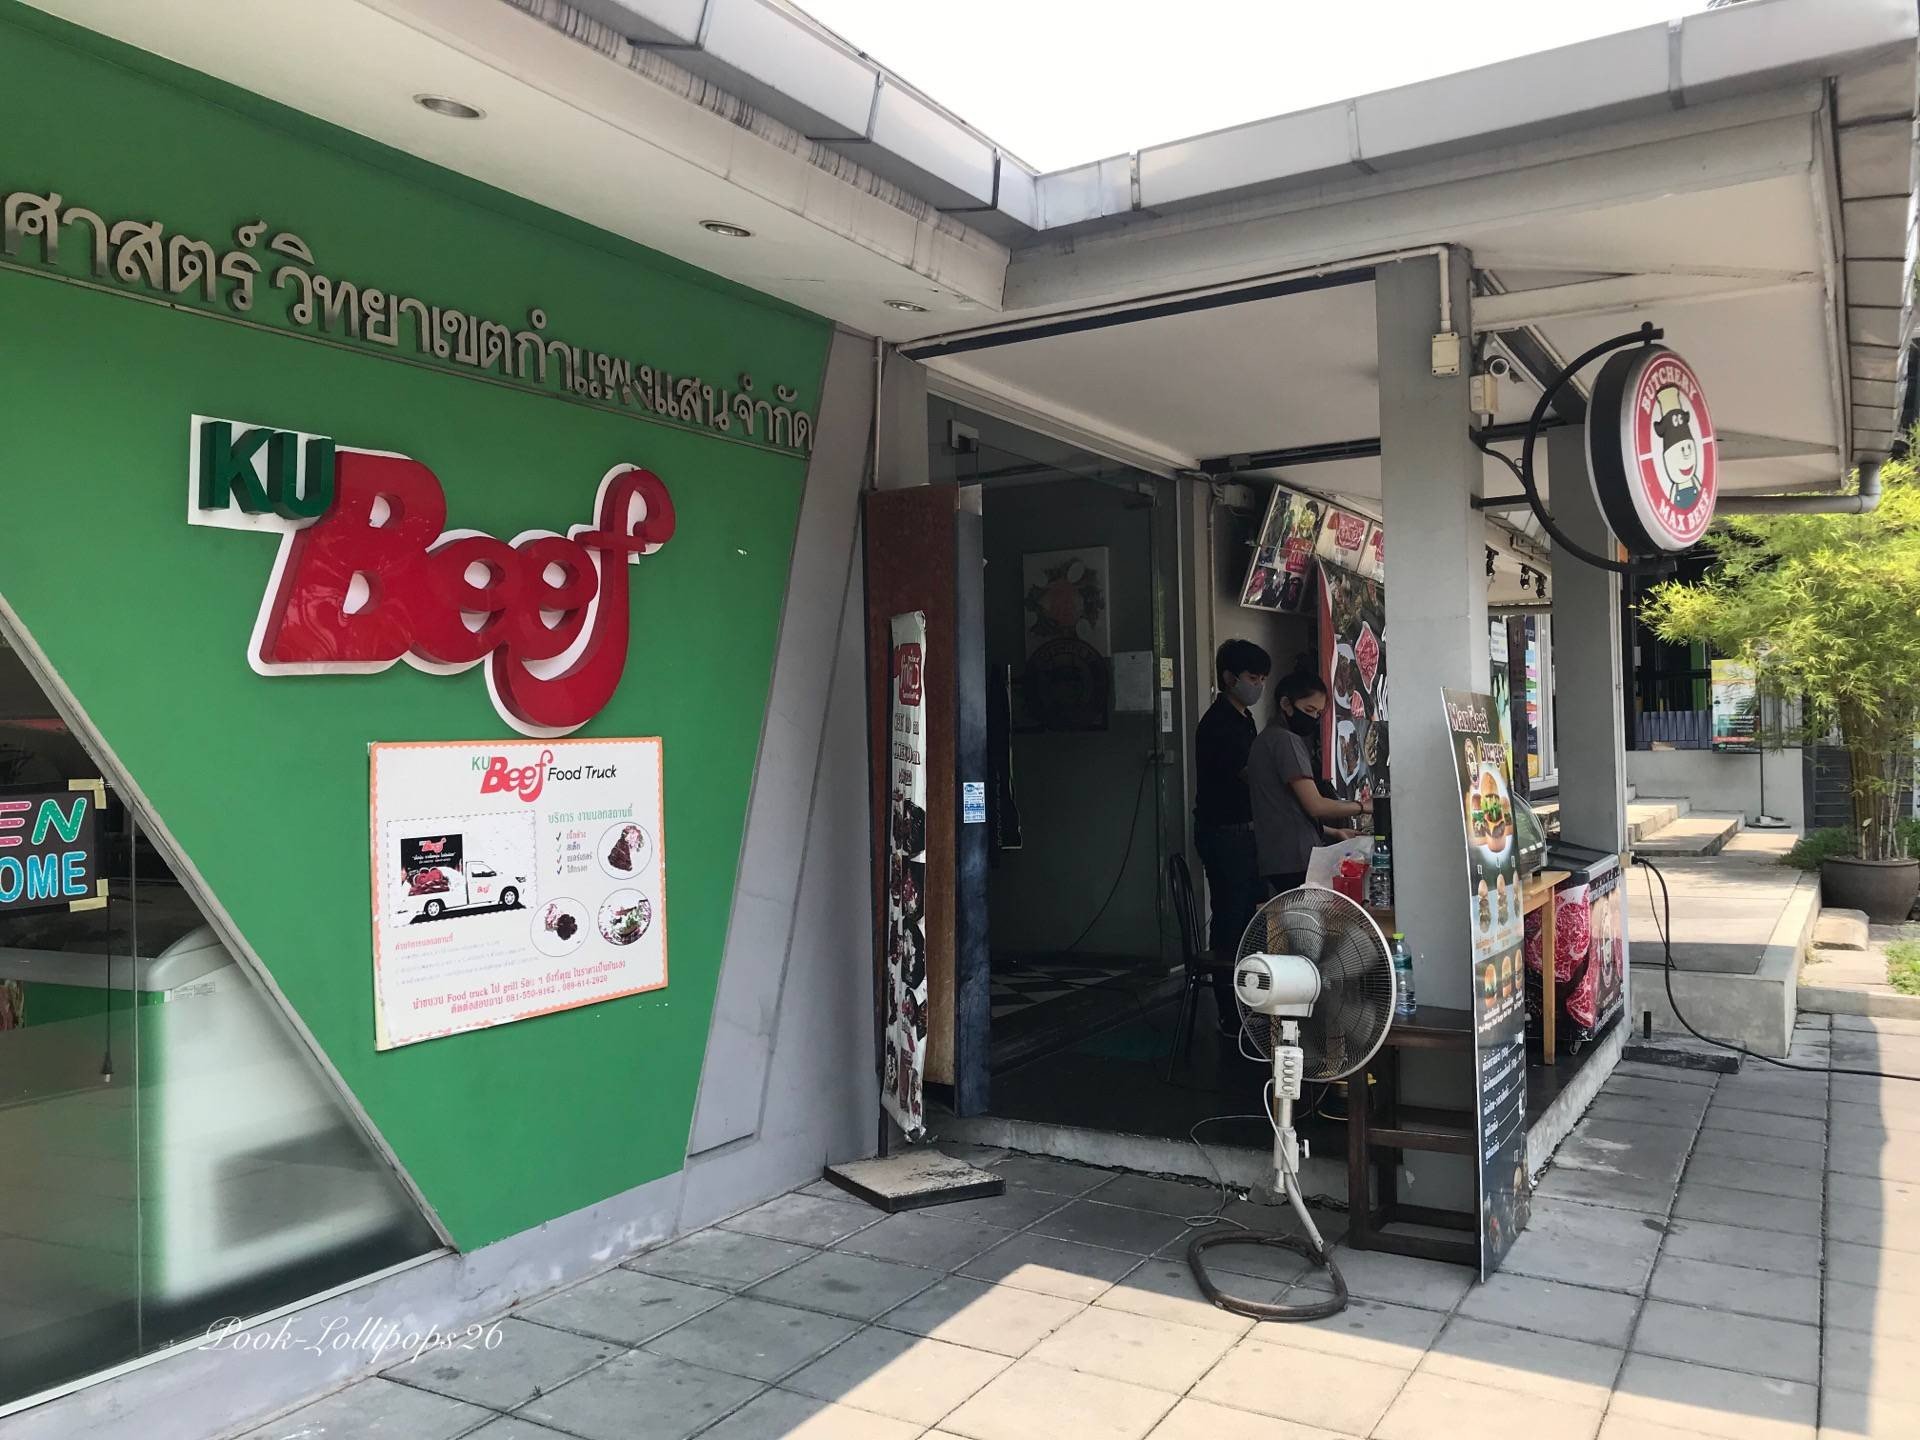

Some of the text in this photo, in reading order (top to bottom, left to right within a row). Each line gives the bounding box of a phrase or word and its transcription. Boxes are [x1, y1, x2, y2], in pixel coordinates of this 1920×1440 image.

[1641, 366, 1697, 414] BUTCHERY
[1658, 487, 1710, 531] MAX BEEF
[199, 419, 676, 730] KU Beef
[471, 749, 617, 802] KU Beef Food Truck
[447, 991, 467, 1004] Food
[469, 987, 488, 999] truck
